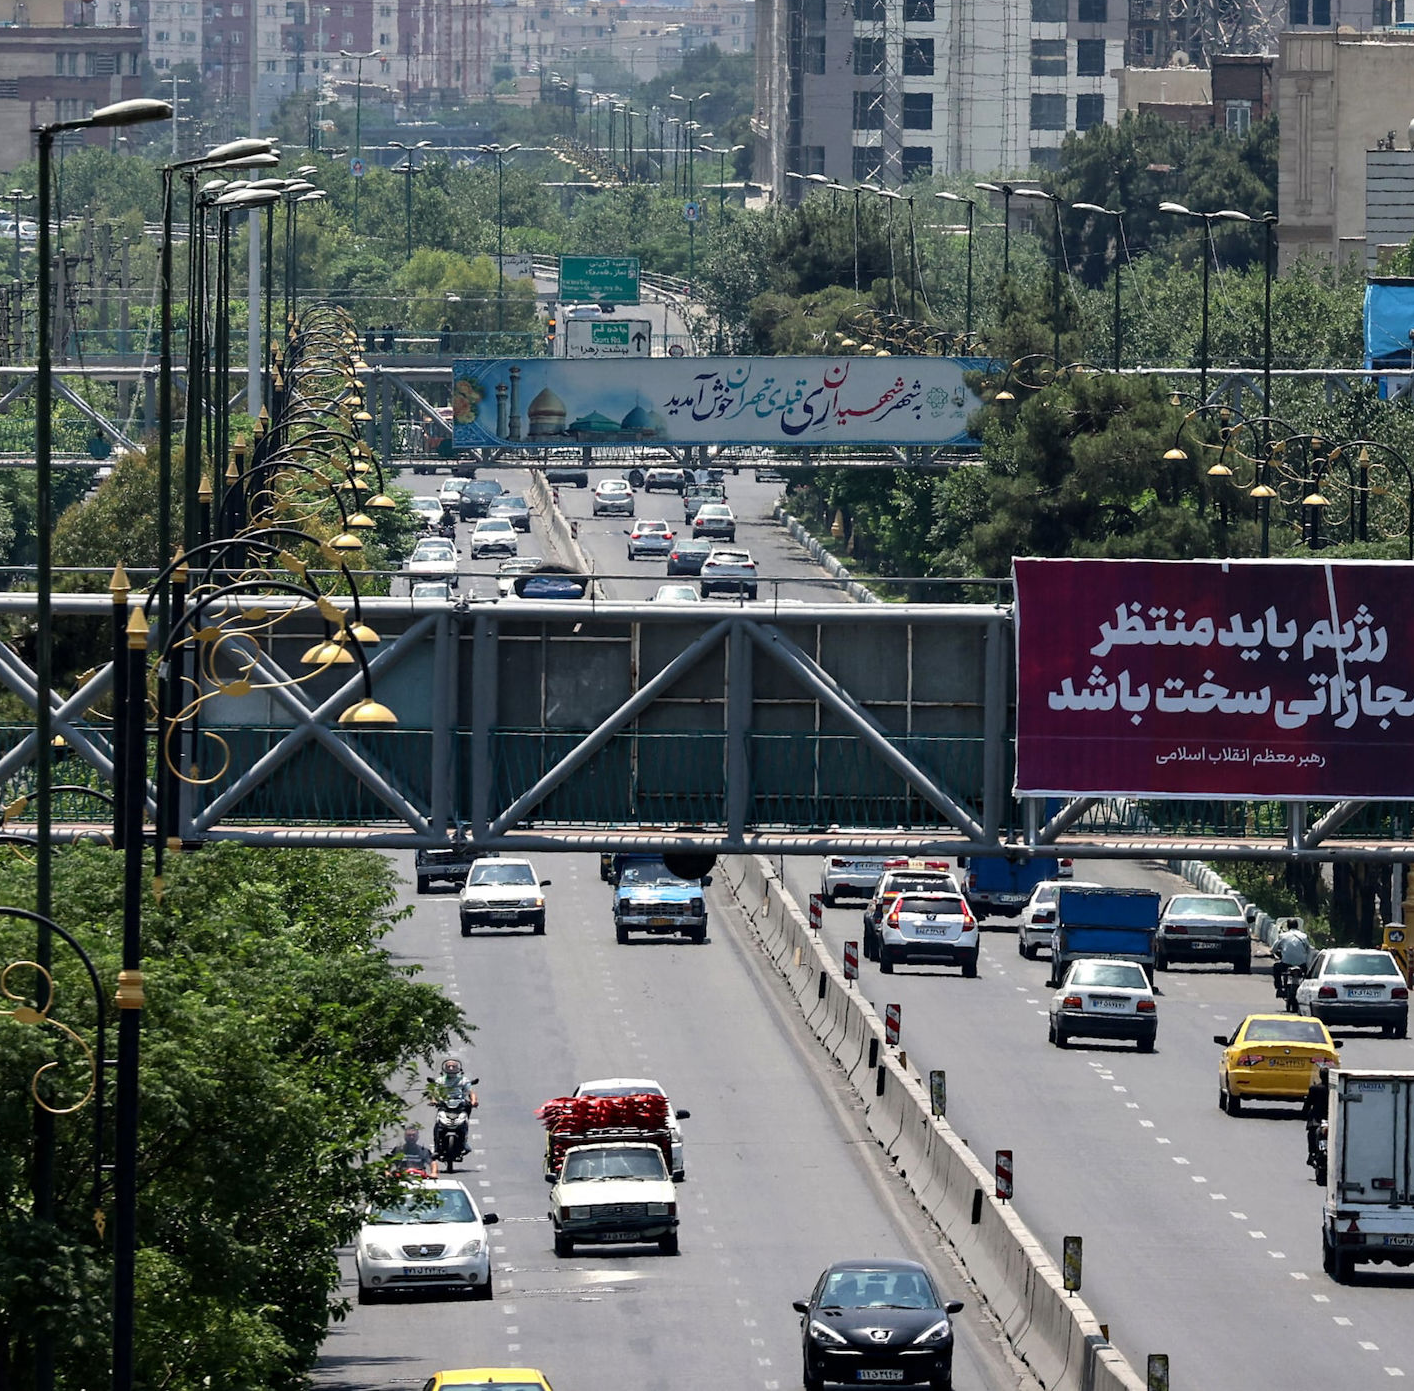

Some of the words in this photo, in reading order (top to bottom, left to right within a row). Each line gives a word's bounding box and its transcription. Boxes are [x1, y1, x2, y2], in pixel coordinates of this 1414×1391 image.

[593, 324, 605, 336] قم
[593, 336, 610, 344] Qom
[607, 325, 628, 335] جاده
[580, 345, 599, 355] زهرا
[602, 345, 629, 355] بهشت
[663, 371, 719, 416] آمدید
[691, 377, 735, 422] خوش
[725, 361, 776, 420] تهران
[824, 361, 904, 426] شهیدان
[869, 378, 922, 423] شهر
[911, 403, 923, 421] به
[1090, 601, 1215, 657] منتظر
[1217, 605, 1298, 662] باید
[1302, 603, 1389, 663] رژیم
[1048, 665, 1151, 726] باشد
[1155, 669, 1271, 715] سخت
[1154, 746, 1206, 766] اسلامی
[1207, 746, 1250, 765] انقلاب
[1252, 747, 1296, 767] معظم
[1295, 752, 1326, 769] رهبر
